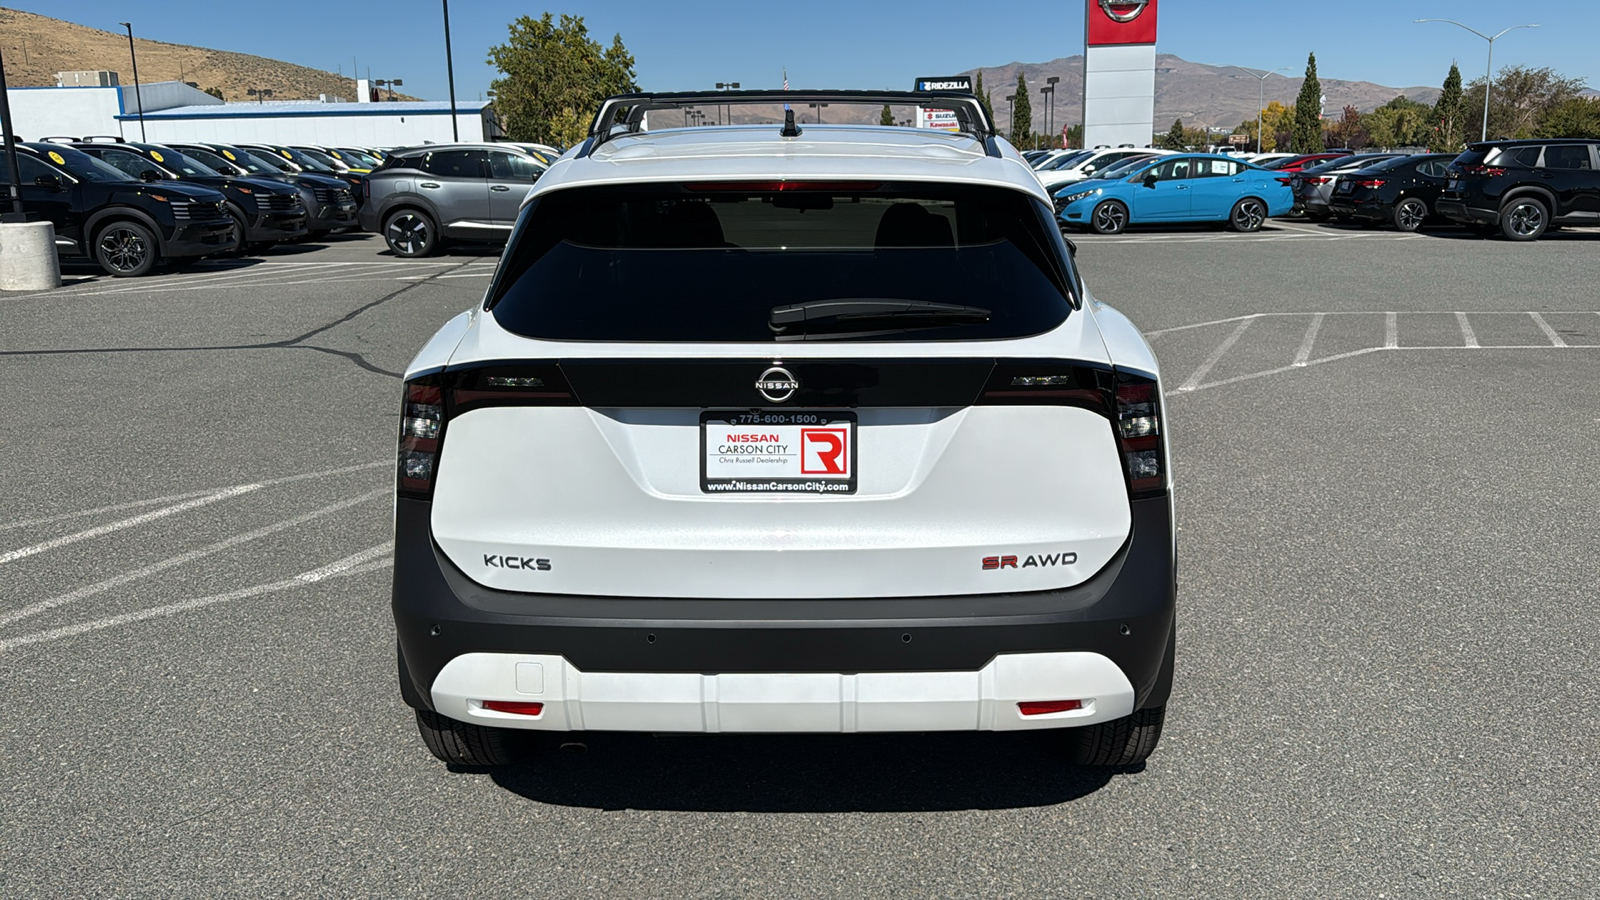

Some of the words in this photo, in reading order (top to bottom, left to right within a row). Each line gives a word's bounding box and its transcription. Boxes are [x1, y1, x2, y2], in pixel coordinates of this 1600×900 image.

[931, 81, 969, 90] RIDEZILLA
[739, 414, 818, 424] 775-600-1500
[727, 434, 779, 443] NISSAN
[718, 445, 764, 454] CARSON
[766, 445, 788, 454] CITY
[756, 457, 788, 465] Dealership
[707, 481, 849, 492] www.NissanCarsonCity.com
[483, 554, 552, 571] KICKS
[982, 555, 1018, 570] SR
[1022, 552, 1078, 568] AWD
